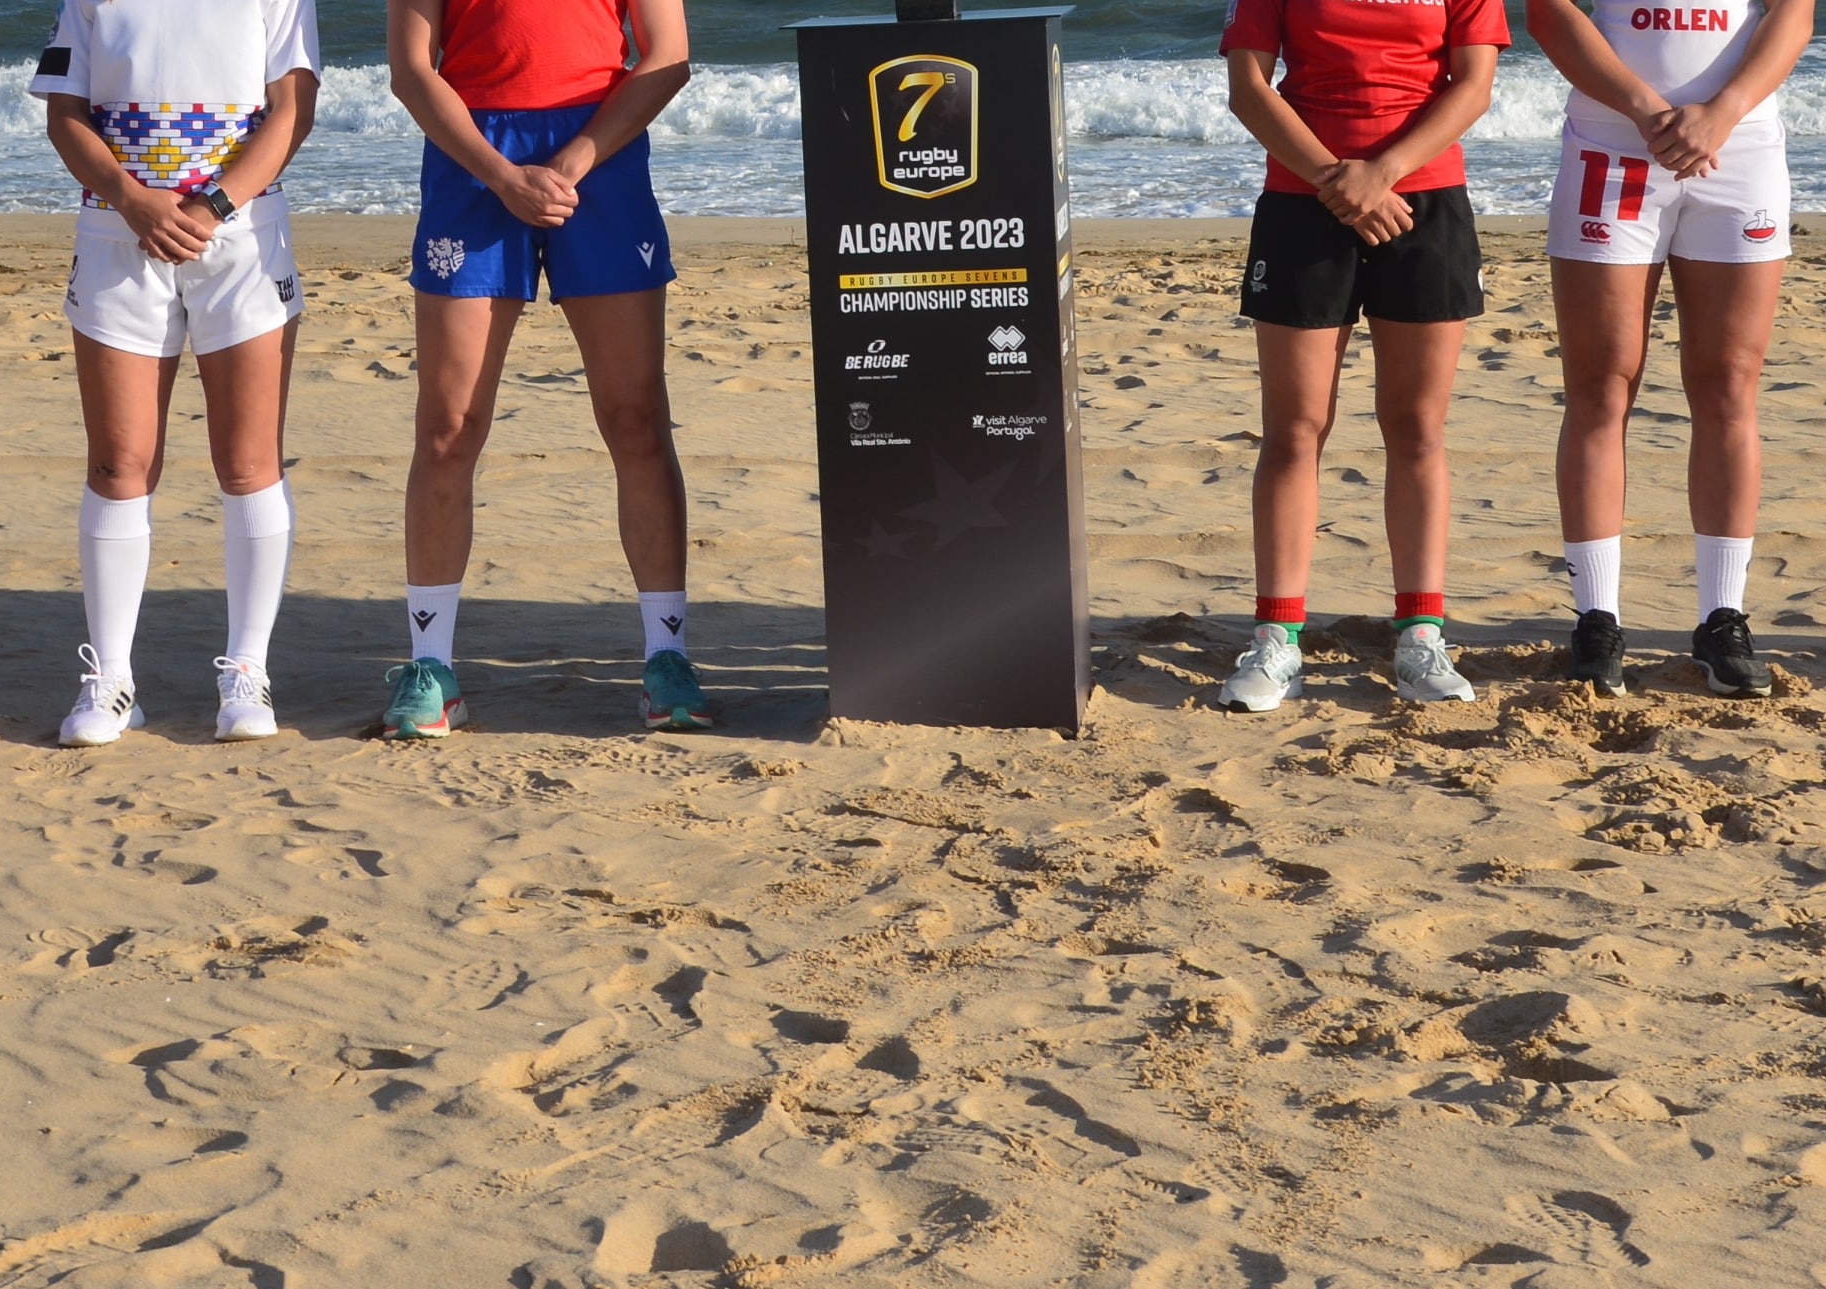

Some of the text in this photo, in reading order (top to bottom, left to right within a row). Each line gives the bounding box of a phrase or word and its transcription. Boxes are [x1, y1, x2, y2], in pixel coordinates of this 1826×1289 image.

[1631, 7, 1728, 32] ORLEN
[899, 147, 958, 165] rugby
[893, 165, 965, 180] europe
[1579, 149, 1650, 222] 11
[838, 220, 952, 254] ALGARVE
[960, 217, 1024, 250] 2023
[849, 271, 1018, 287] RUGBY EUROPE SEVENS
[840, 287, 1029, 313] CHAMPIONSHIP SERIES
[985, 415, 1047, 426] visit Algarve
[986, 426, 1035, 441] Portugal
